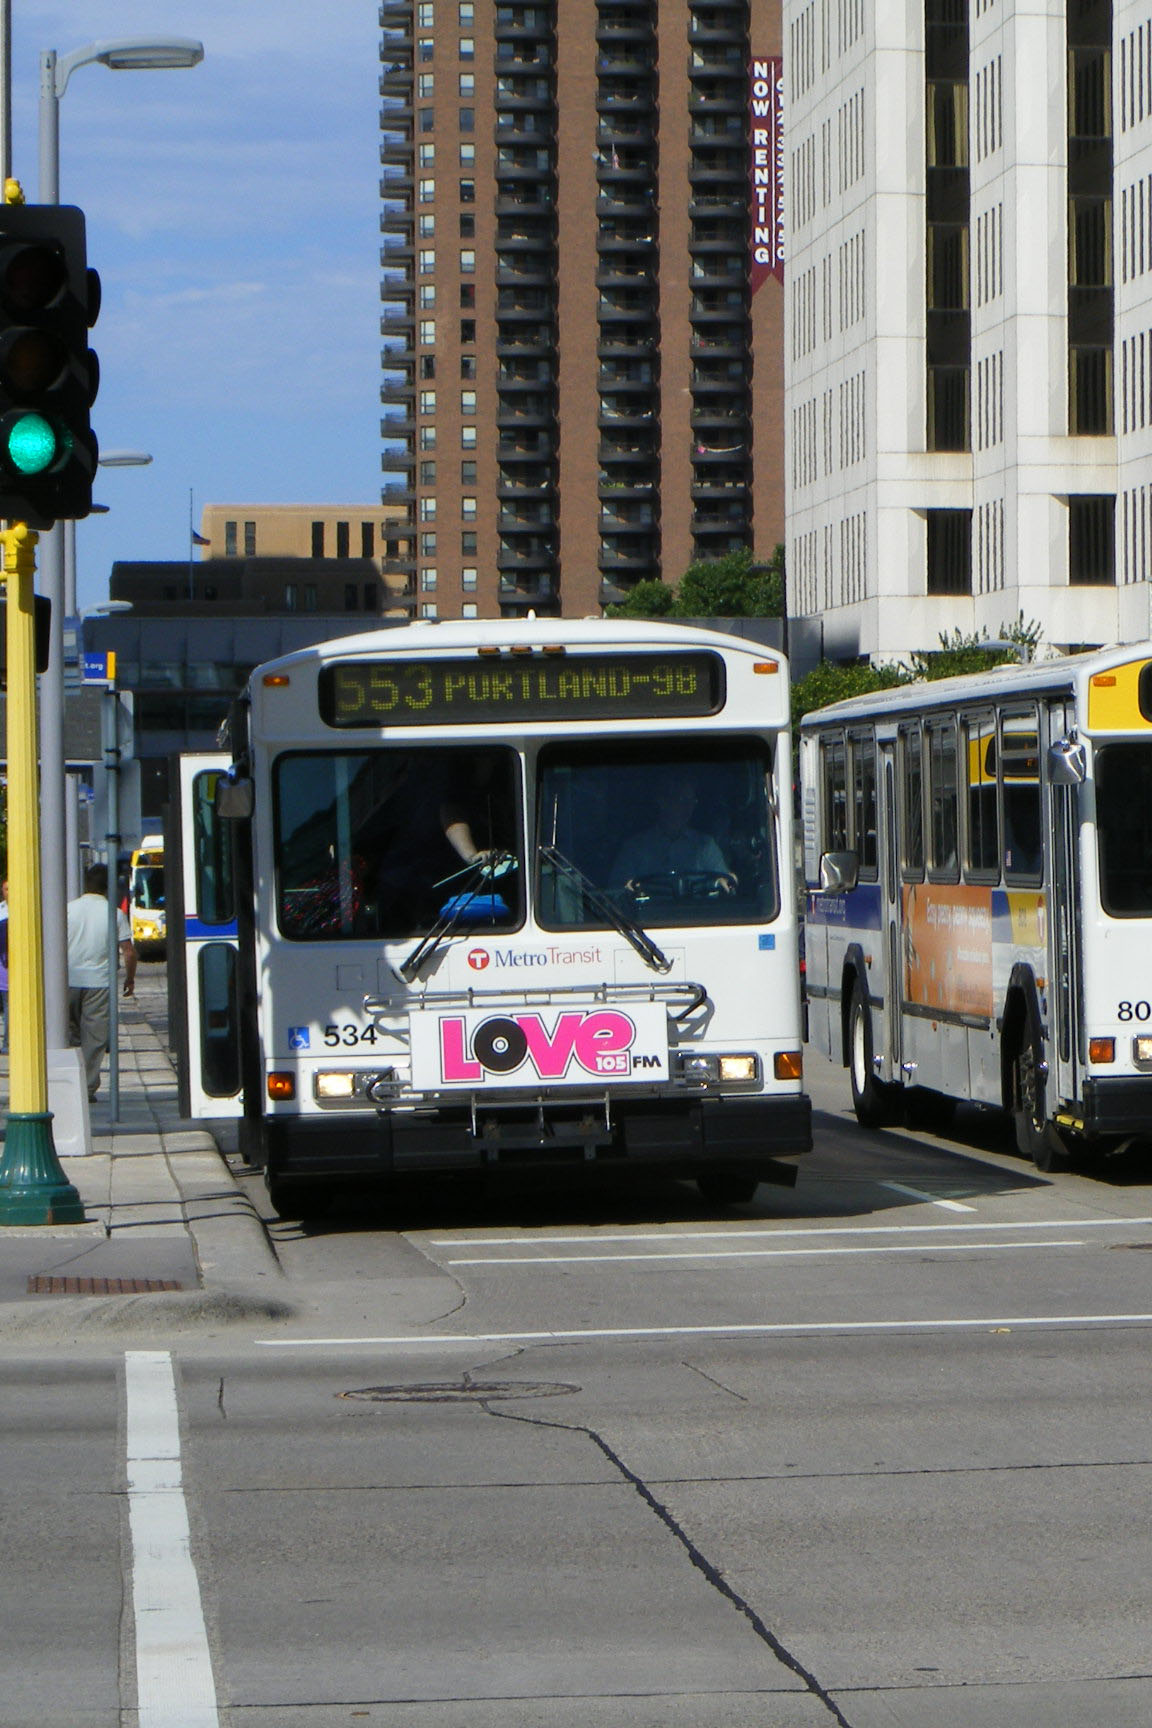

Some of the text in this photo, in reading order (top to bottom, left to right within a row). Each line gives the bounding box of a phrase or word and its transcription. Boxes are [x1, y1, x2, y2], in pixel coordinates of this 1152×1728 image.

[753, 61, 770, 265] NOW RENTING
[336, 664, 433, 711] 553
[323, 1025, 378, 1047] 534
[595, 1054, 663, 1073] 105 FM
